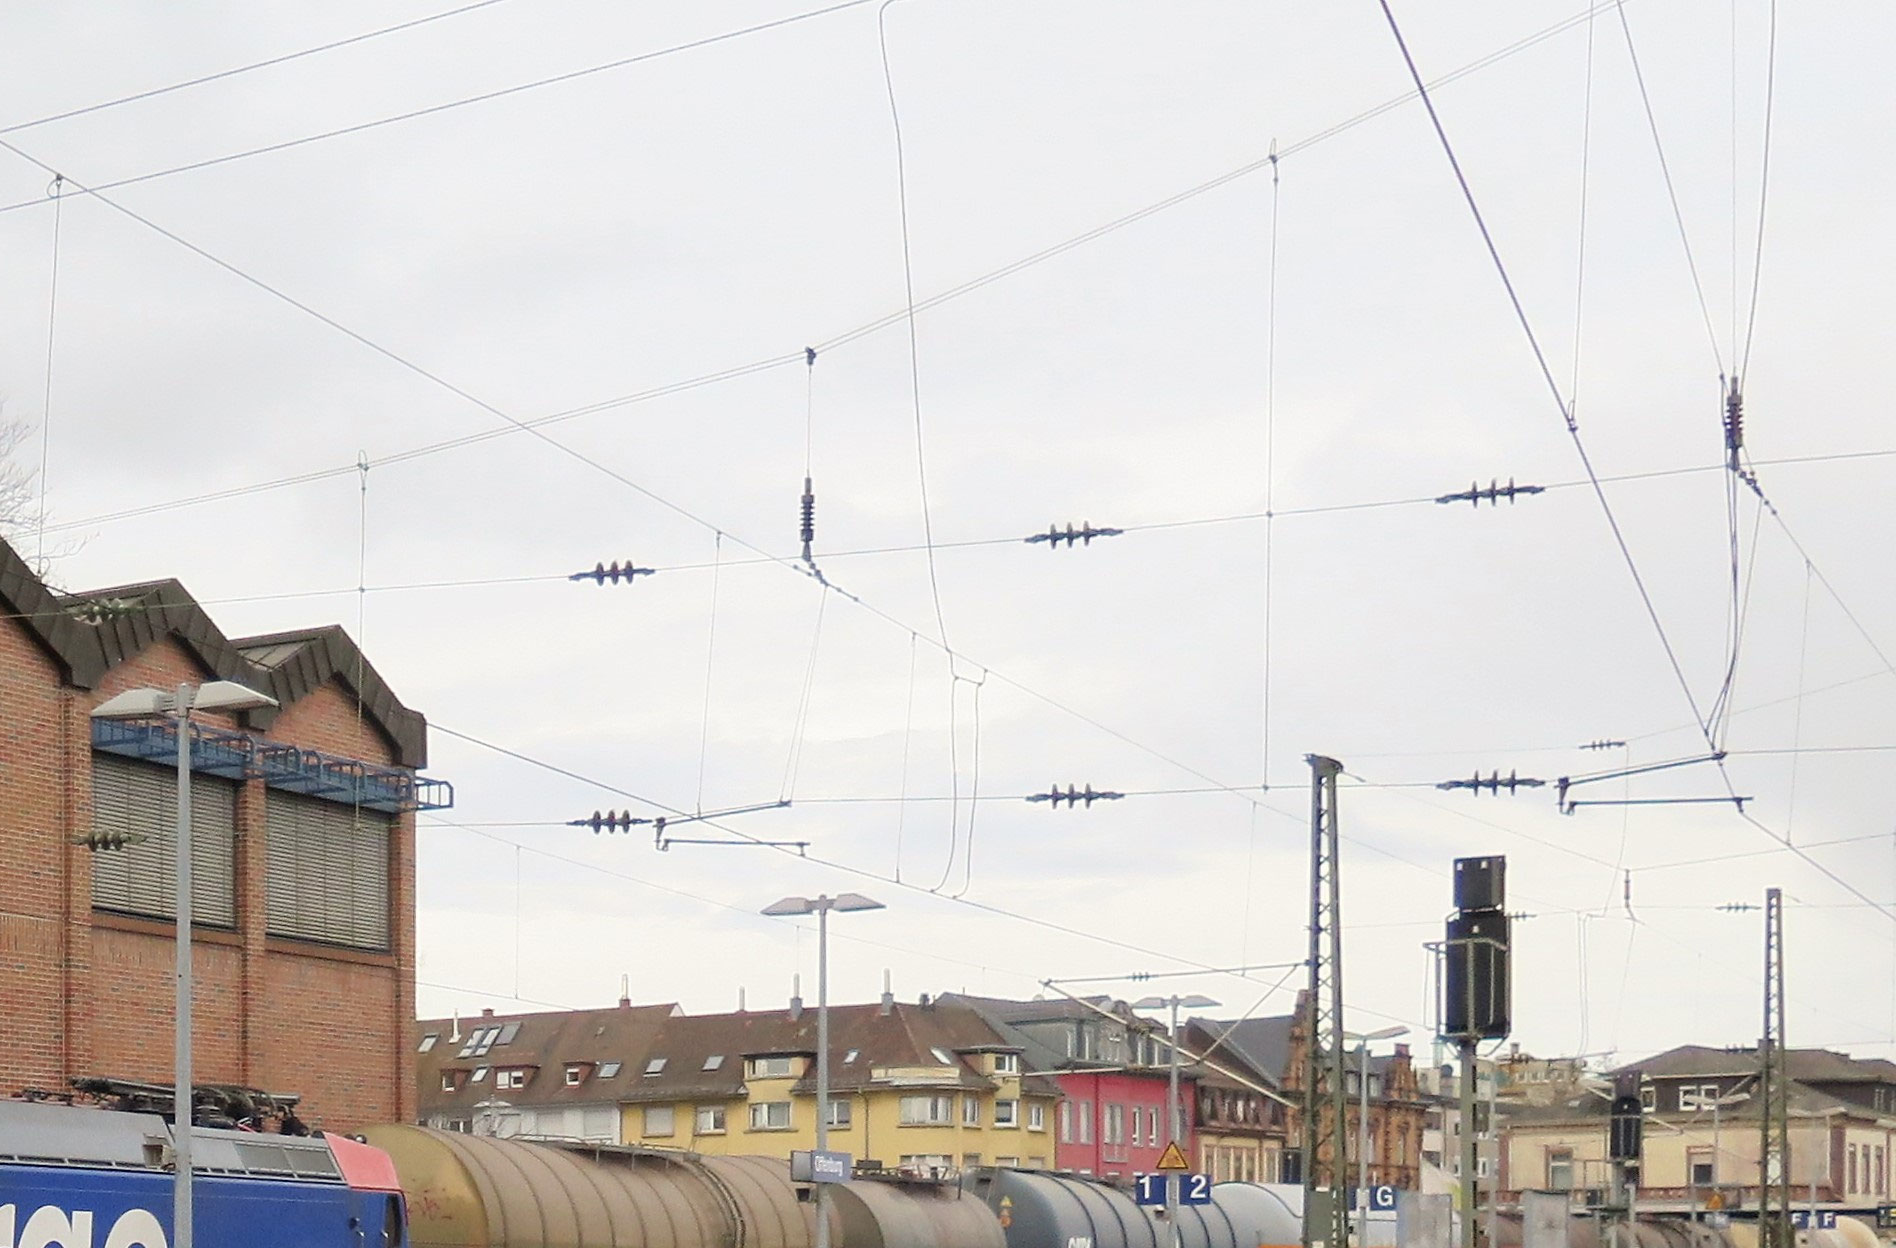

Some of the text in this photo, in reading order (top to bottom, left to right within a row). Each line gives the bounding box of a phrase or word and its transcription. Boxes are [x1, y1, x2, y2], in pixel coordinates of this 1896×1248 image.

[1138, 1176, 1151, 1199] 1
[1190, 1174, 1207, 1199] 2
[1376, 1186, 1394, 1206] G
[1791, 1212, 1802, 1225] F
[1823, 1212, 1834, 1226] F
